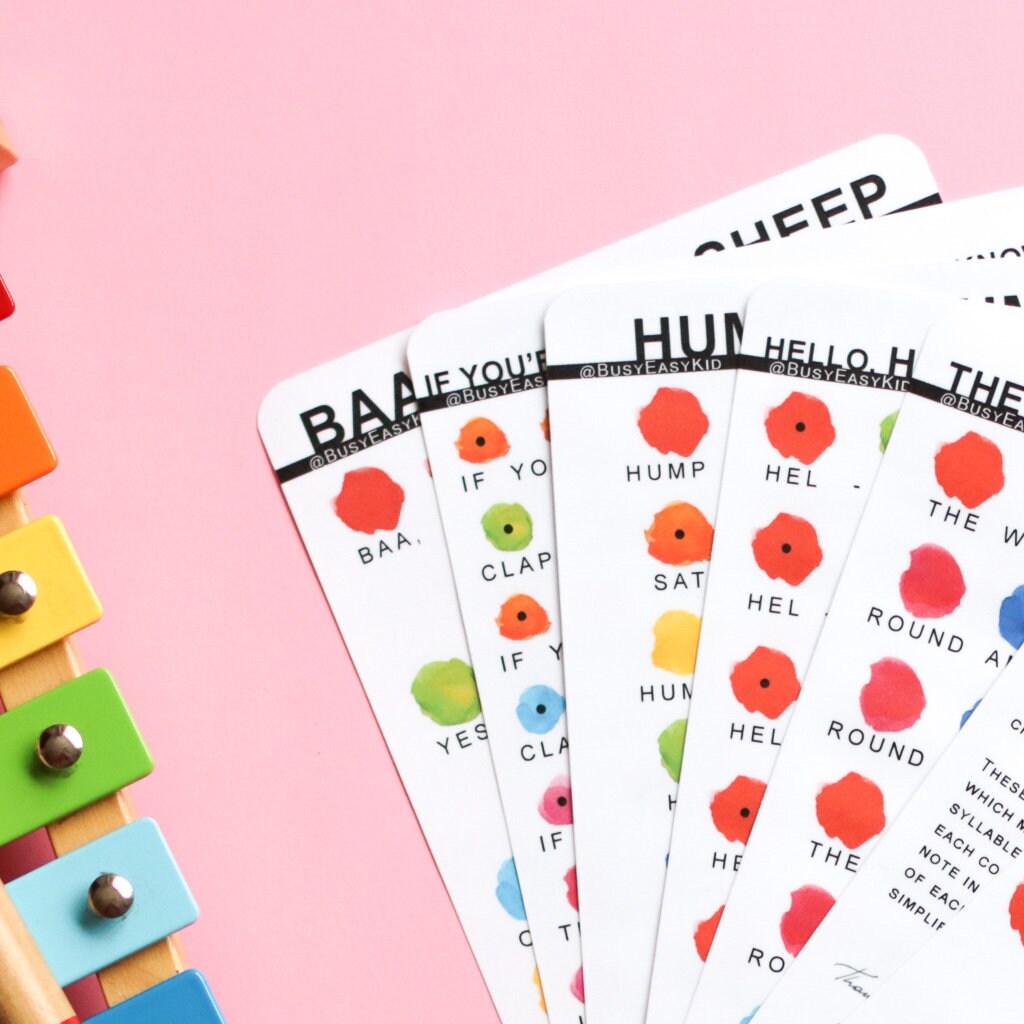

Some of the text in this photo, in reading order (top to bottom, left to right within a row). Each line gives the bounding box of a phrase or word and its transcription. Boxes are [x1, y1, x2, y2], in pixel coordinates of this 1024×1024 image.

[764, 336, 875, 375] HELLO,
[424, 371, 449, 397] IF
[461, 459, 547, 492] IF YO
[626, 461, 706, 482] HUMP
[765, 464, 818, 488] HEL
[929, 499, 980, 533] THE
[357, 531, 423, 565] BAA,
[481, 551, 552, 582] CLAP
[653, 570, 706, 592] SAT
[747, 593, 800, 617] HEL
[866, 606, 1013, 668] ROUND A
[500, 643, 562, 673] IF Y
[436, 723, 489, 756] YES
[520, 737, 570, 762] CLA
[729, 722, 782, 747] HEL
[827, 720, 925, 768] ROUND
[965, 780, 1015, 823] WHICH
[540, 832, 564, 853] IF
[949, 803, 1023, 860] SYLLABLE
[809, 840, 862, 873] THE
[934, 823, 1001, 876] EACH CO
[918, 844, 981, 894] NOTE IN
[904, 867, 966, 913] OF EAC
[558, 921, 581, 942] T
[747, 947, 786, 974] RO
